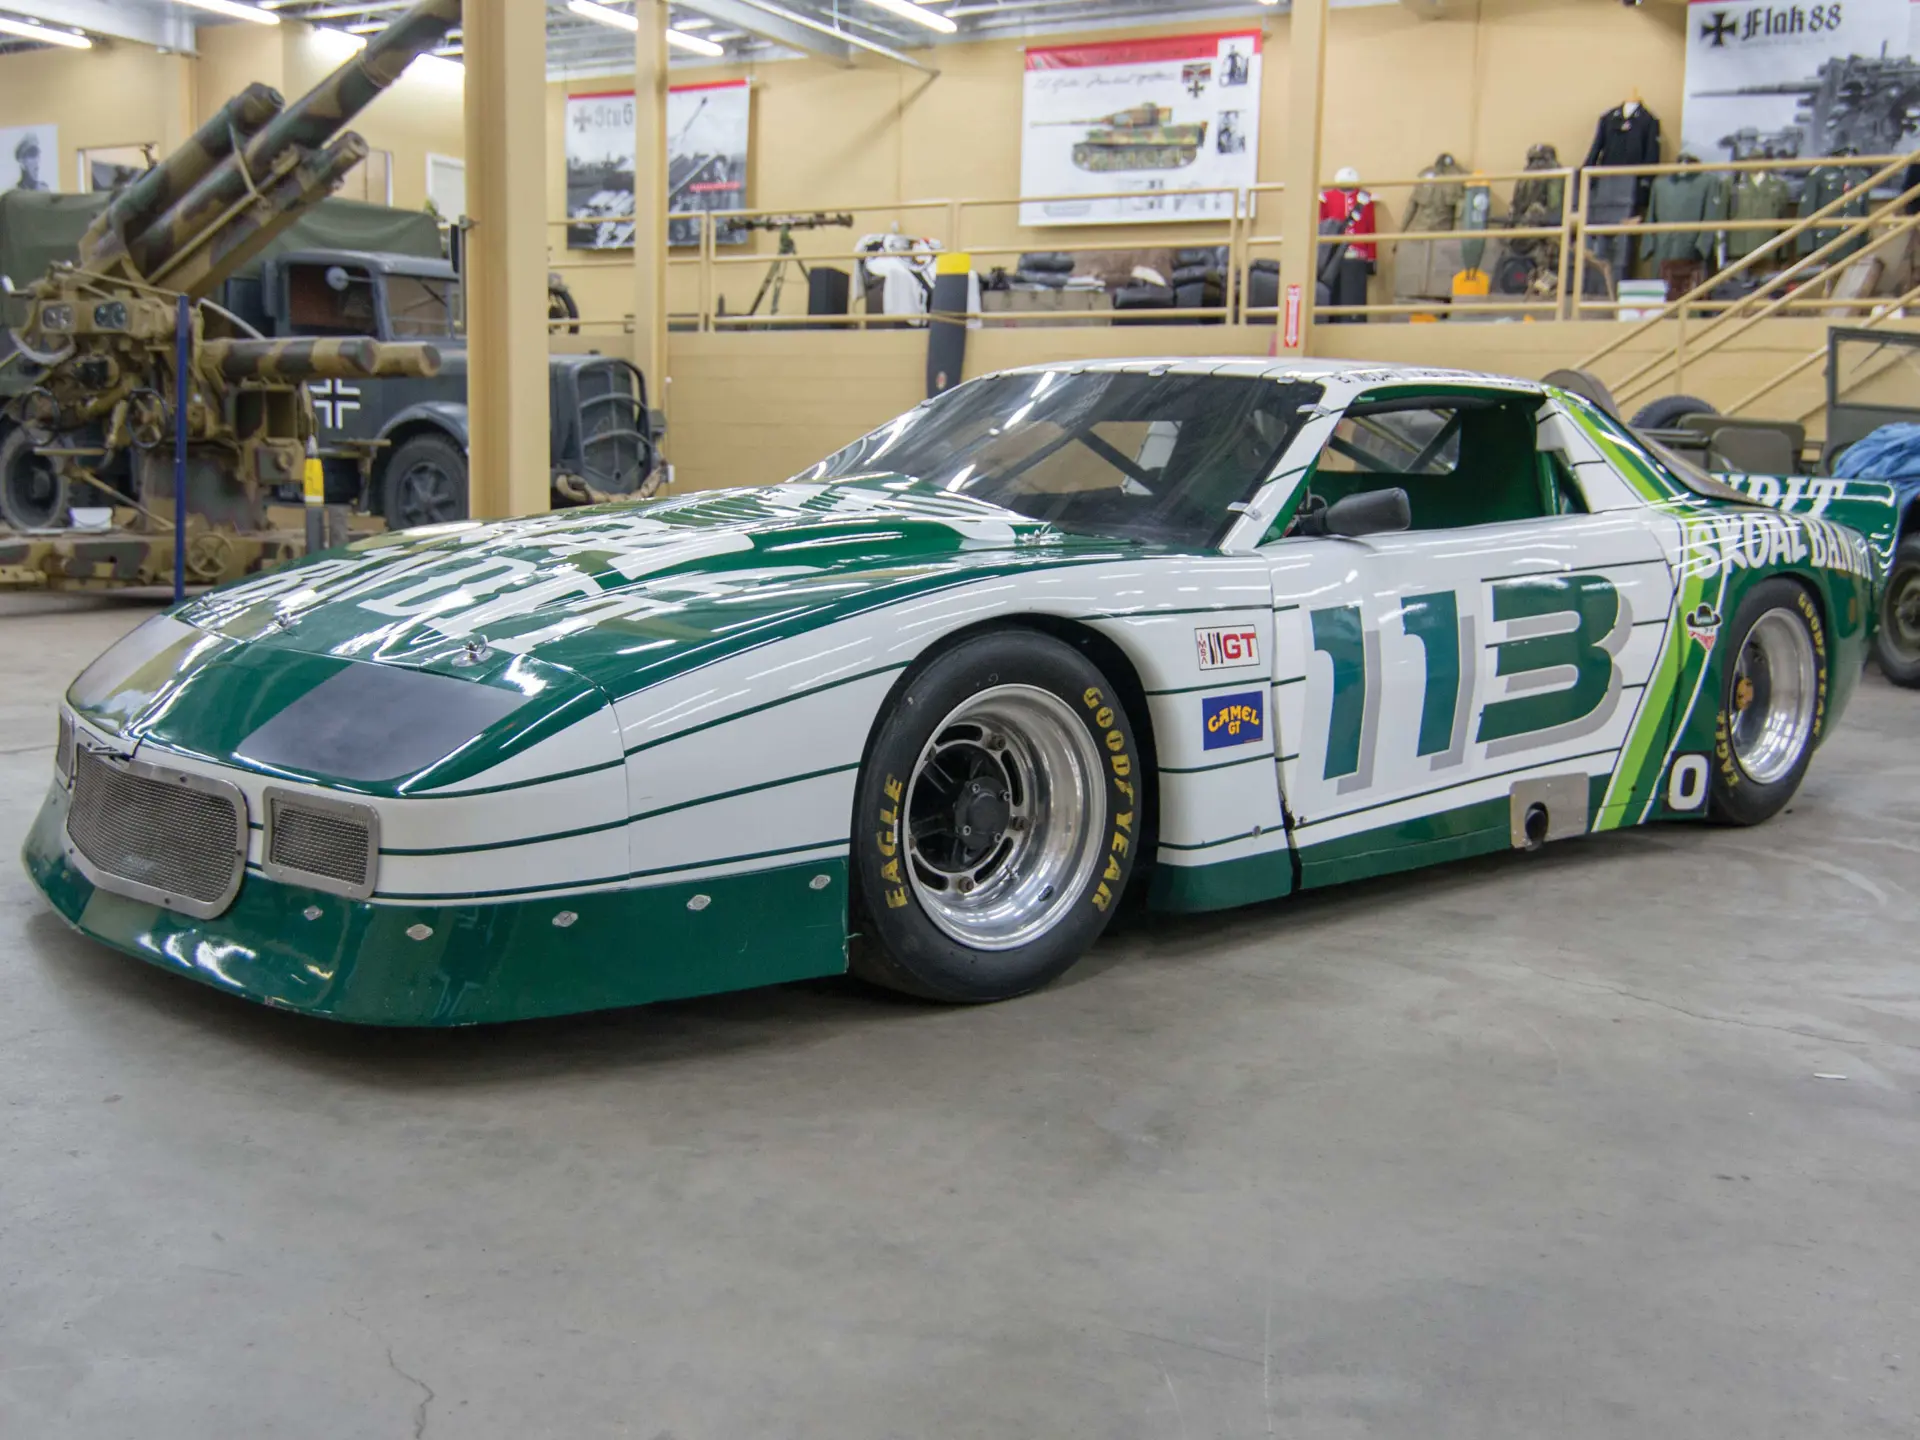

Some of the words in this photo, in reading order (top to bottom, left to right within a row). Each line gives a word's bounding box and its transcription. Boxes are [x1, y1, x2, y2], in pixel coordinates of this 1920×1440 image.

[1742, 6, 1804, 41] Flak
[1808, 3, 1841, 31] 88
[1691, 513, 1807, 579] SKOAL
[1801, 516, 1873, 581] BAN
[1223, 633, 1256, 659] GT
[1310, 575, 1628, 790] 113
[1207, 705, 1259, 732] CAMEL
[1228, 721, 1241, 735] GT
[877, 773, 907, 908] EAGLE
